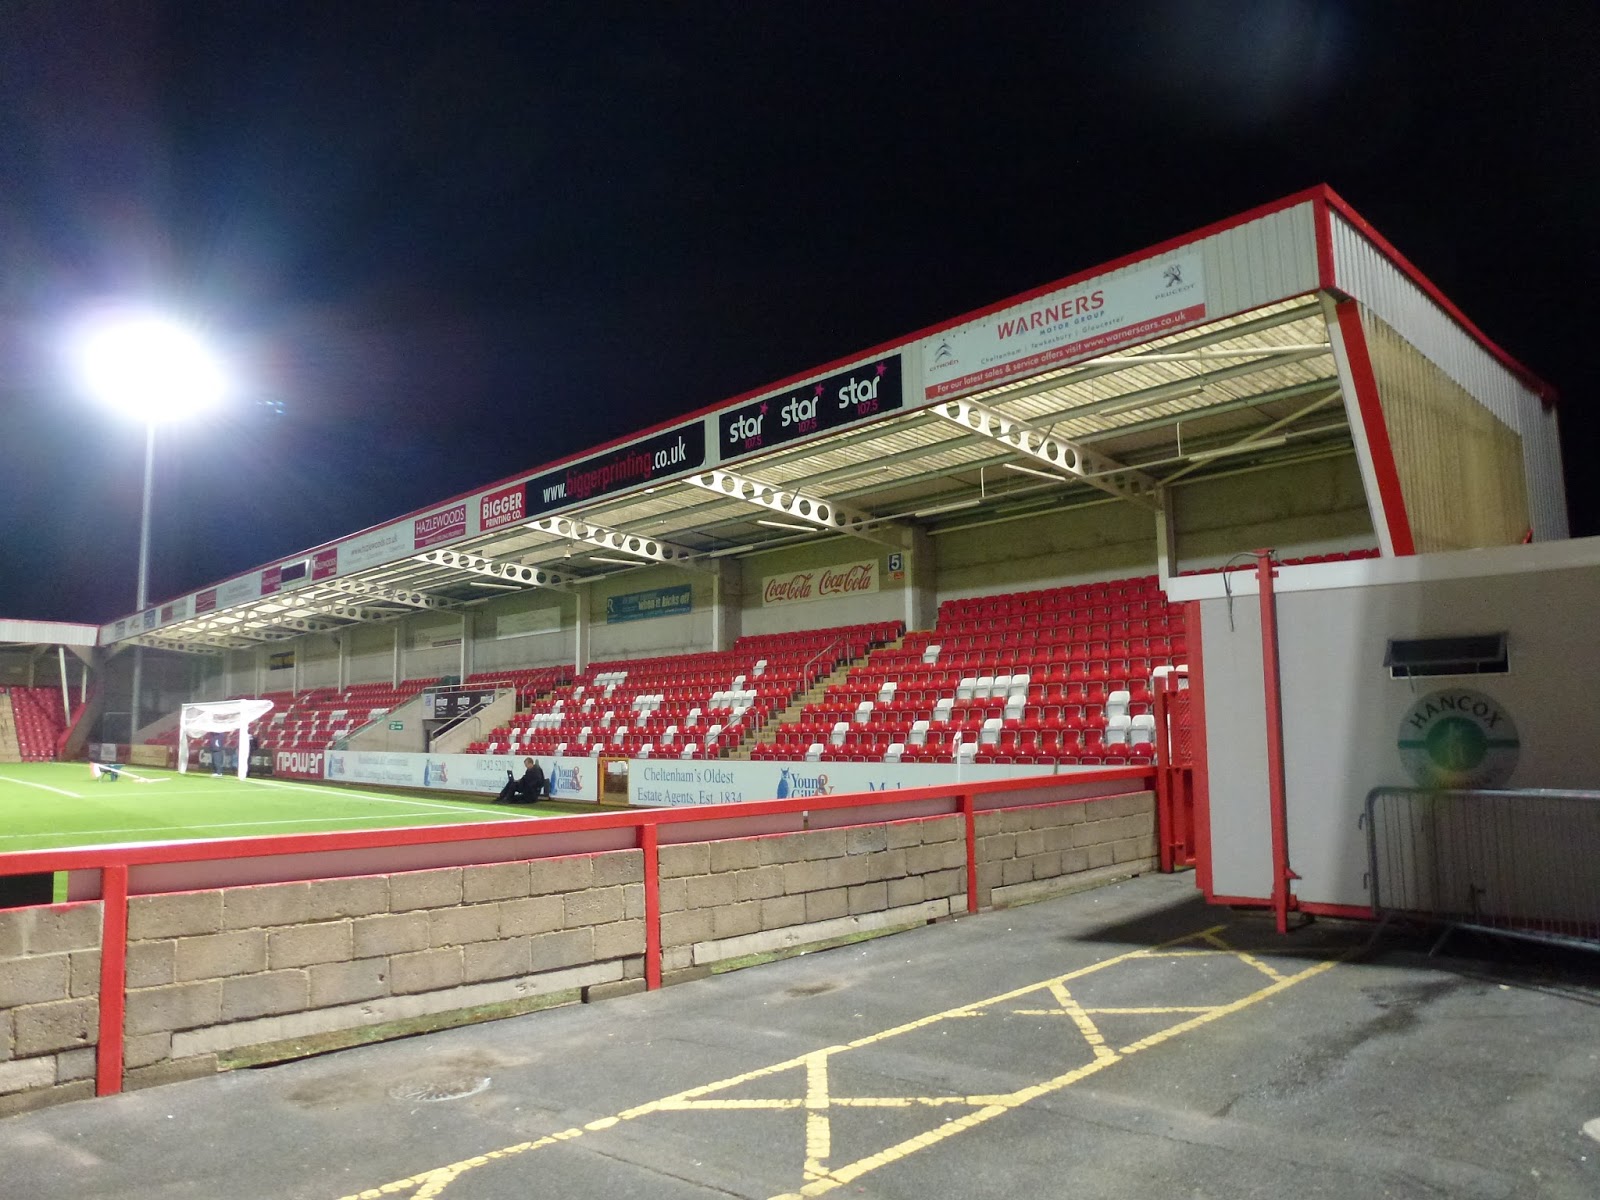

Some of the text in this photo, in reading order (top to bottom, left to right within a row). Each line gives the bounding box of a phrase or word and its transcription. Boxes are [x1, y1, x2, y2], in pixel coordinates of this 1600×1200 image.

[1154, 284, 1196, 300] PEUGEOT
[997, 290, 1104, 340] WARNERS
[1039, 310, 1105, 336] MOTOR GROUP
[937, 311, 1186, 393] For our latest sales & service offers visit www.warnerscars.co.uk
[981, 316, 1124, 364] Cheltenham Tewkesbury Gloucester
[838, 375, 880, 409] star
[781, 395, 819, 427] star
[857, 399, 879, 415] 107.5
[729, 414, 764, 443] star
[798, 418, 818, 433] 107.5
[744, 435, 762, 449] 107.5
[543, 436, 686, 503] www.biggerprinting.co.uk
[483, 492, 522, 519] BIGGER
[486, 510, 522, 528] PRINTING CO.
[415, 507, 465, 535] HAZLEWOODS
[891, 554, 900, 570] 5
[764, 564, 874, 603] Coca-Cola Coca-Cola
[1410, 695, 1505, 729] HANCOX
[643, 767, 735, 784] Cheltenham's Oldest
[791, 773, 825, 793] Young
[637, 787, 742, 807] Estate Agents, Est. 1834
